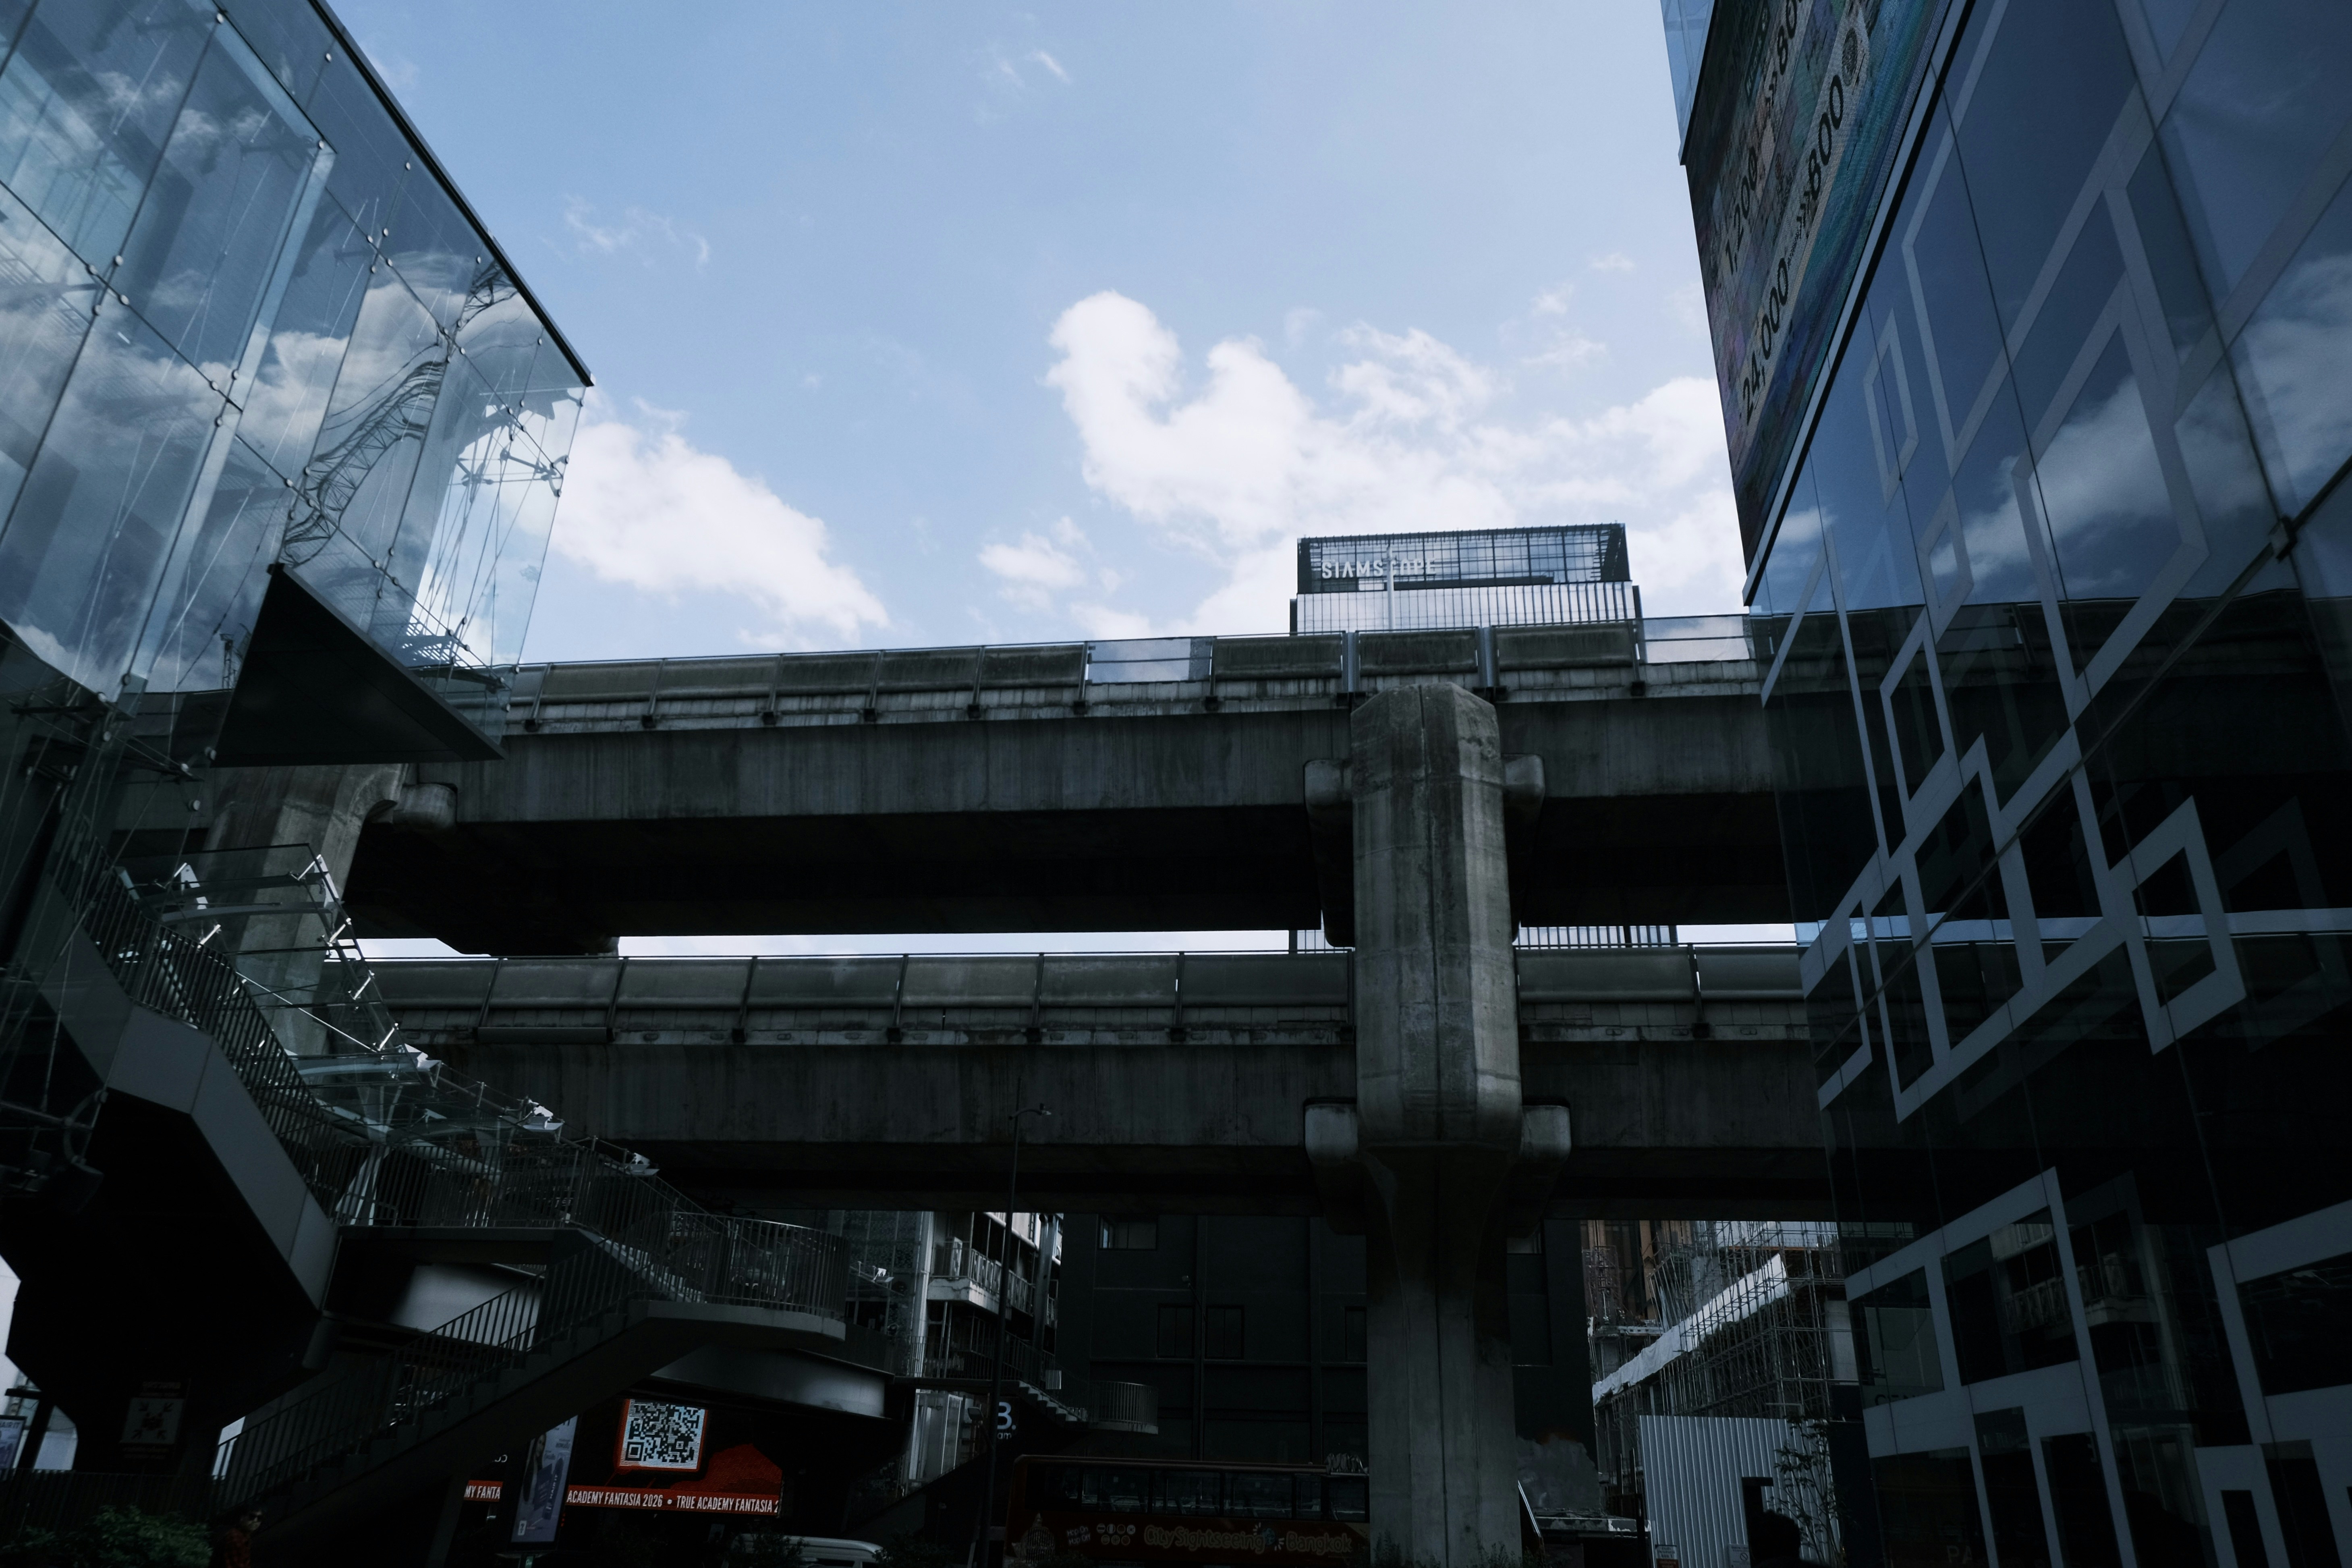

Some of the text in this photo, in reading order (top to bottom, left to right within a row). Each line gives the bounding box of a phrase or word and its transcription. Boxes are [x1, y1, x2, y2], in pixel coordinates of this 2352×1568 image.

[1777, 0, 1802, 75] 80
[1742, 257, 1788, 426] 24,000
[1808, 75, 1844, 200] 800
[477, 1486, 501, 1499] FANTA
[566, 1490, 664, 1508] ACADEMY FANTASIA 2026
[676, 1495, 697, 1509] TRUE
[697, 1496, 735, 1511] ACADEMY
[734, 1498, 773, 1513] FANTASIA
[1286, 1531, 1352, 1556] Bangkok
